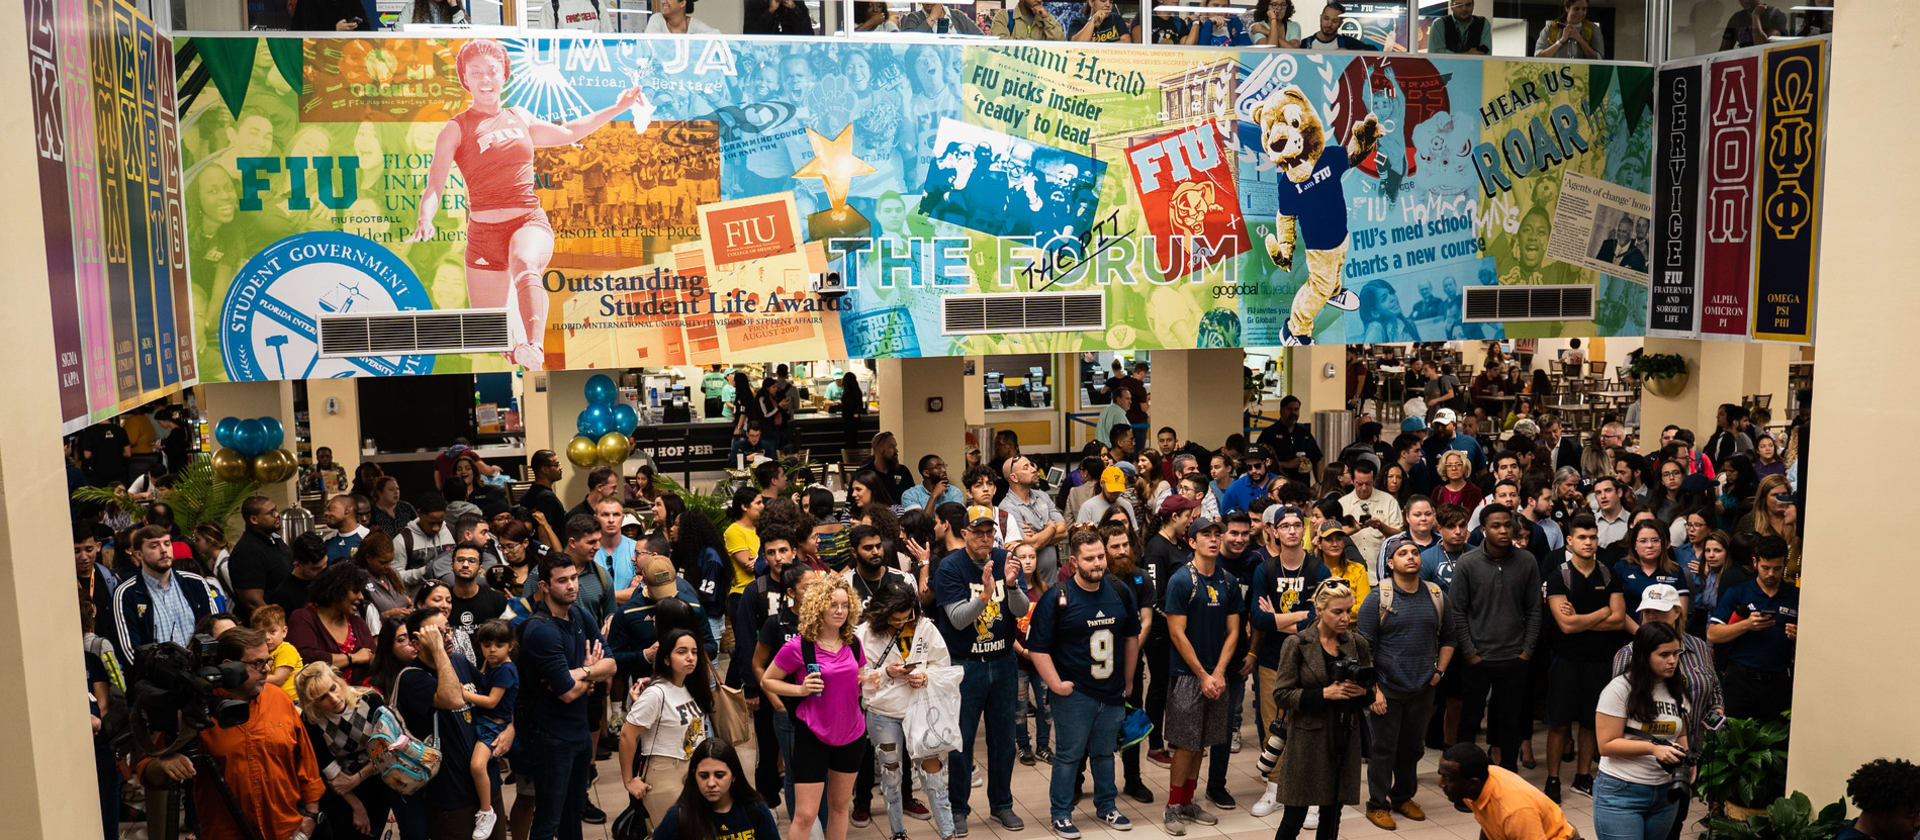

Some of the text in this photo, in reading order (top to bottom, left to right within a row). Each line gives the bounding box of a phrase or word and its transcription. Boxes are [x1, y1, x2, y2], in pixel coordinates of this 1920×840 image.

[406, 64, 434, 81] MI
[568, 76, 723, 95] African Heritage
[971, 64, 1103, 122] FIU picks insider
[1479, 66, 1576, 130] HEAR US
[1034, 113, 1050, 134] to
[1055, 120, 1091, 147] lead
[1130, 123, 1221, 194] FIU
[1304, 182, 1315, 191] am
[1314, 166, 1333, 185] FIU
[1666, 76, 1688, 267] SERVICE
[237, 155, 360, 212] FIU
[1593, 188, 1602, 198] of
[331, 215, 402, 225] FIU FOOTBALL
[1392, 218, 1424, 244] med
[1427, 208, 1474, 237] school
[554, 227, 597, 240] eason
[602, 225, 617, 238] at
[621, 228, 630, 237] a
[633, 222, 662, 237] fast
[722, 215, 775, 248] FIU
[1021, 209, 1120, 289] THE PIT
[1345, 236, 1487, 280] charts a new course
[828, 234, 1239, 290] THE FORUM
[542, 267, 705, 298] Outstanding
[1664, 271, 1683, 285] FIU
[231, 243, 410, 333] STUDENT GOVERNMENT
[1212, 281, 1259, 299] goglobal
[1653, 286, 1694, 295] FRATERNITY
[599, 289, 853, 317] Student Life Awards
[1711, 295, 1739, 305] ALPHA
[1767, 294, 1800, 305] OMEGA
[259, 299, 293, 321] FLORIDA
[1656, 306, 1689, 314] SORORITY
[1664, 315, 1679, 323] LIFE
[1704, 306, 1744, 317] OMICRON
[1775, 306, 1790, 316] PSI
[552, 322, 587, 330] FLORIDA
[588, 320, 654, 330] INTERNATIONAL
[756, 316, 792, 325] STUDENT
[794, 315, 823, 324] AFFAIRS
[1719, 318, 1728, 328] PI
[1774, 318, 1790, 329] PHI
[742, 325, 801, 342] AUGUST 2009
[63, 371, 80, 388] KAPPA
[700, 578, 717, 596] 12
[968, 579, 1006, 603] FU
[1275, 576, 1305, 593] FIU
[1086, 616, 1116, 628] PANTHERS
[970, 639, 1006, 654] ALUMNI
[1089, 628, 1115, 680] 9
